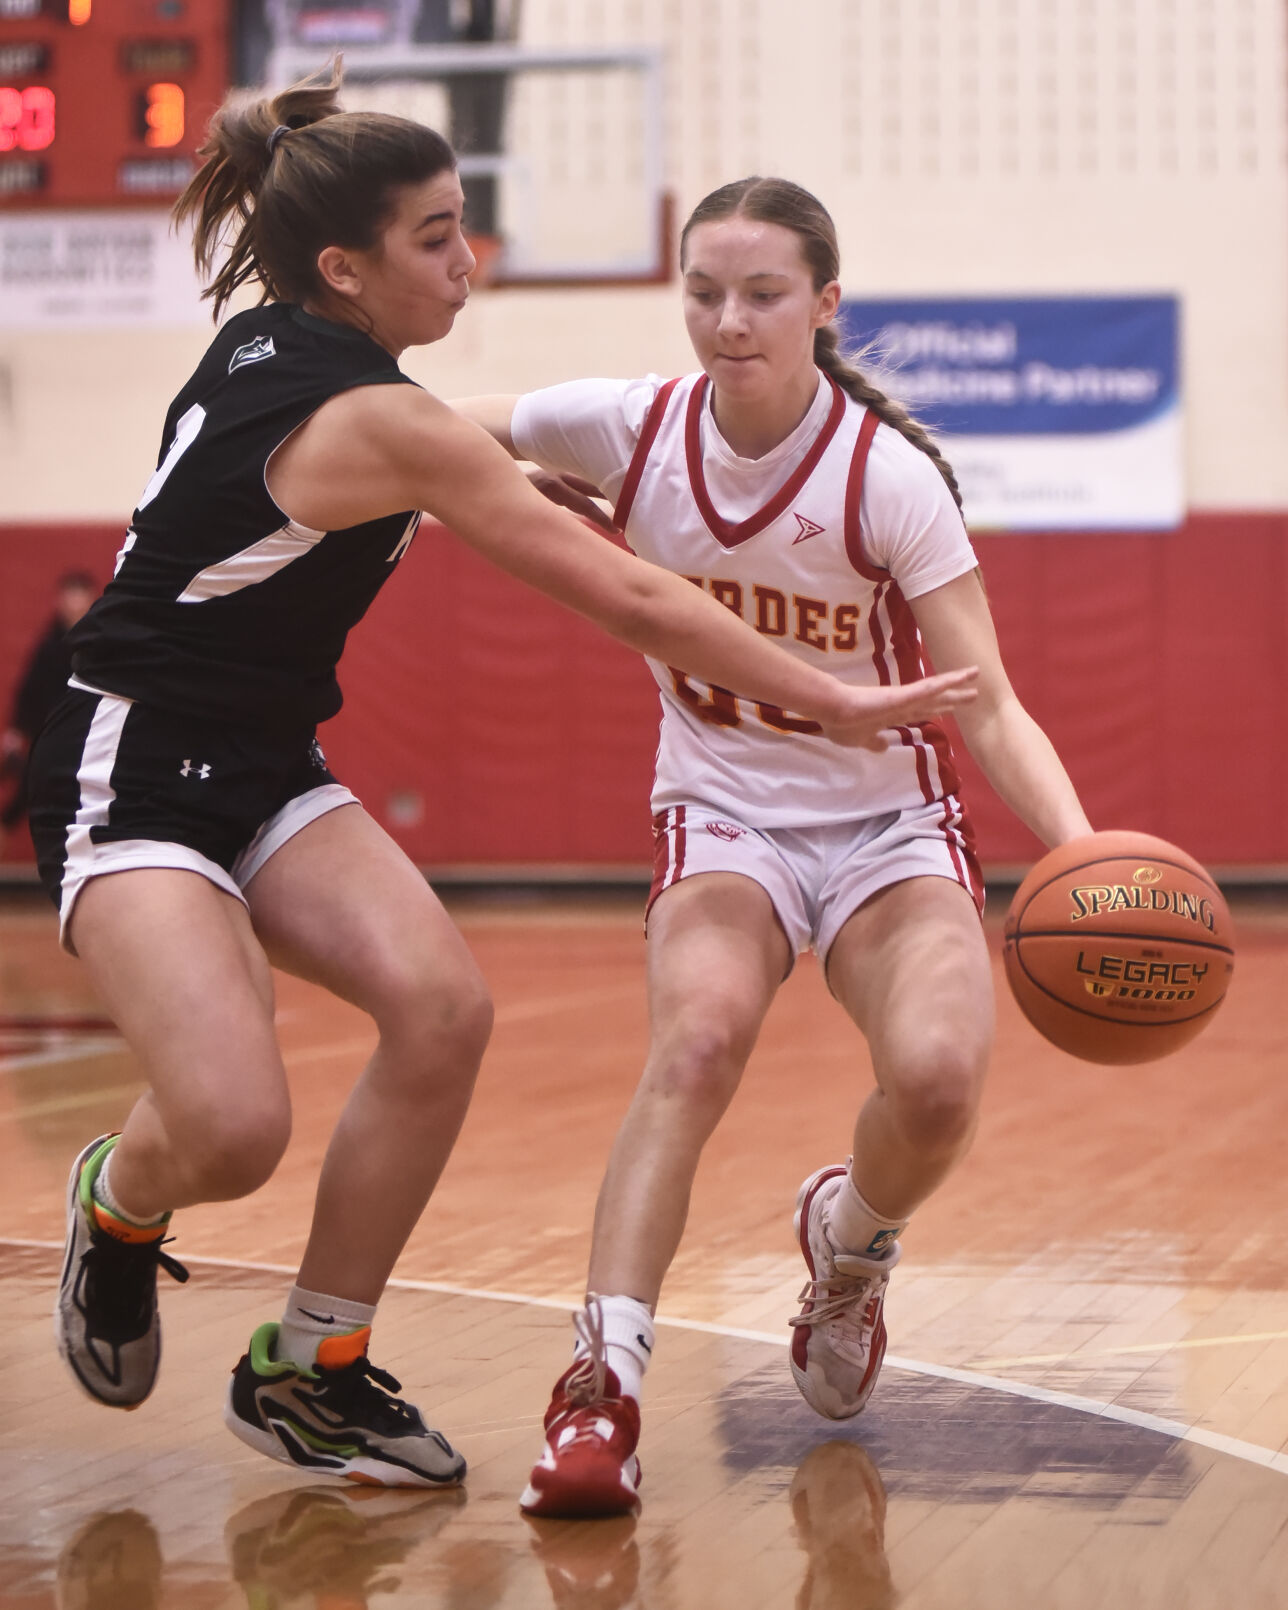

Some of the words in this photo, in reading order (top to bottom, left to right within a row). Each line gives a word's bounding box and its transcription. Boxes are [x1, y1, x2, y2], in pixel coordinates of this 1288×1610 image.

[145, 83, 185, 148] 3
[1070, 885, 1217, 933] SPALDING
[1076, 951, 1209, 985] LEGACY
[1117, 986, 1196, 1001] 1000
